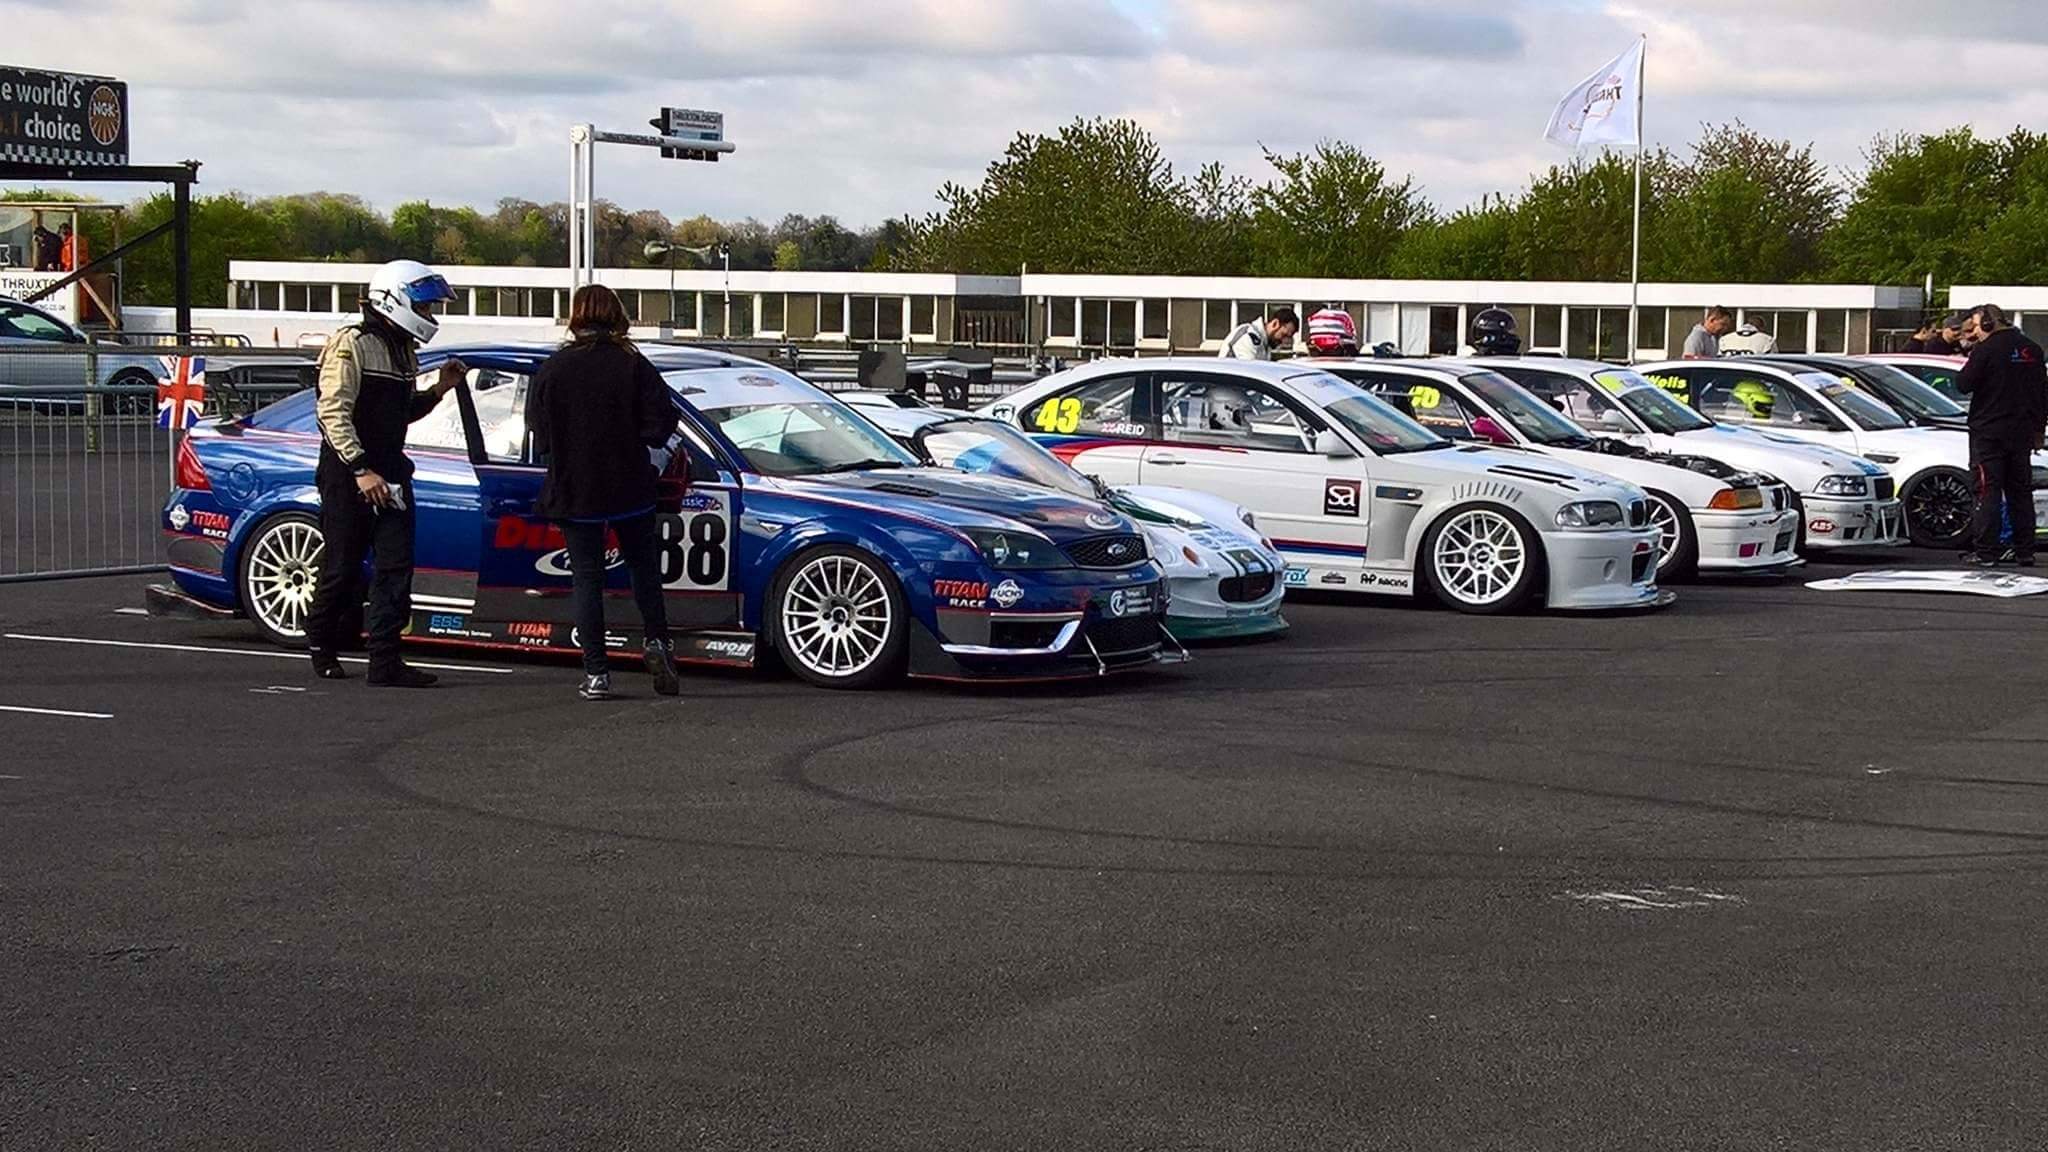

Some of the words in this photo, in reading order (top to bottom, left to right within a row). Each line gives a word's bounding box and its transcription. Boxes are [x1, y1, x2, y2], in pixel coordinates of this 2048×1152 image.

[15, 80, 81, 109] world's
[93, 102, 116, 118] NGK
[24, 111, 82, 142] choice
[1036, 397, 1082, 434] 43
[1116, 423, 1145, 436] REID
[1328, 485, 1356, 507] sa
[934, 580, 988, 599] TITAN
[949, 598, 986, 608] RACE
[508, 623, 551, 637] TITAN
[519, 636, 551, 646] RACE
[705, 640, 753, 653] AVON
